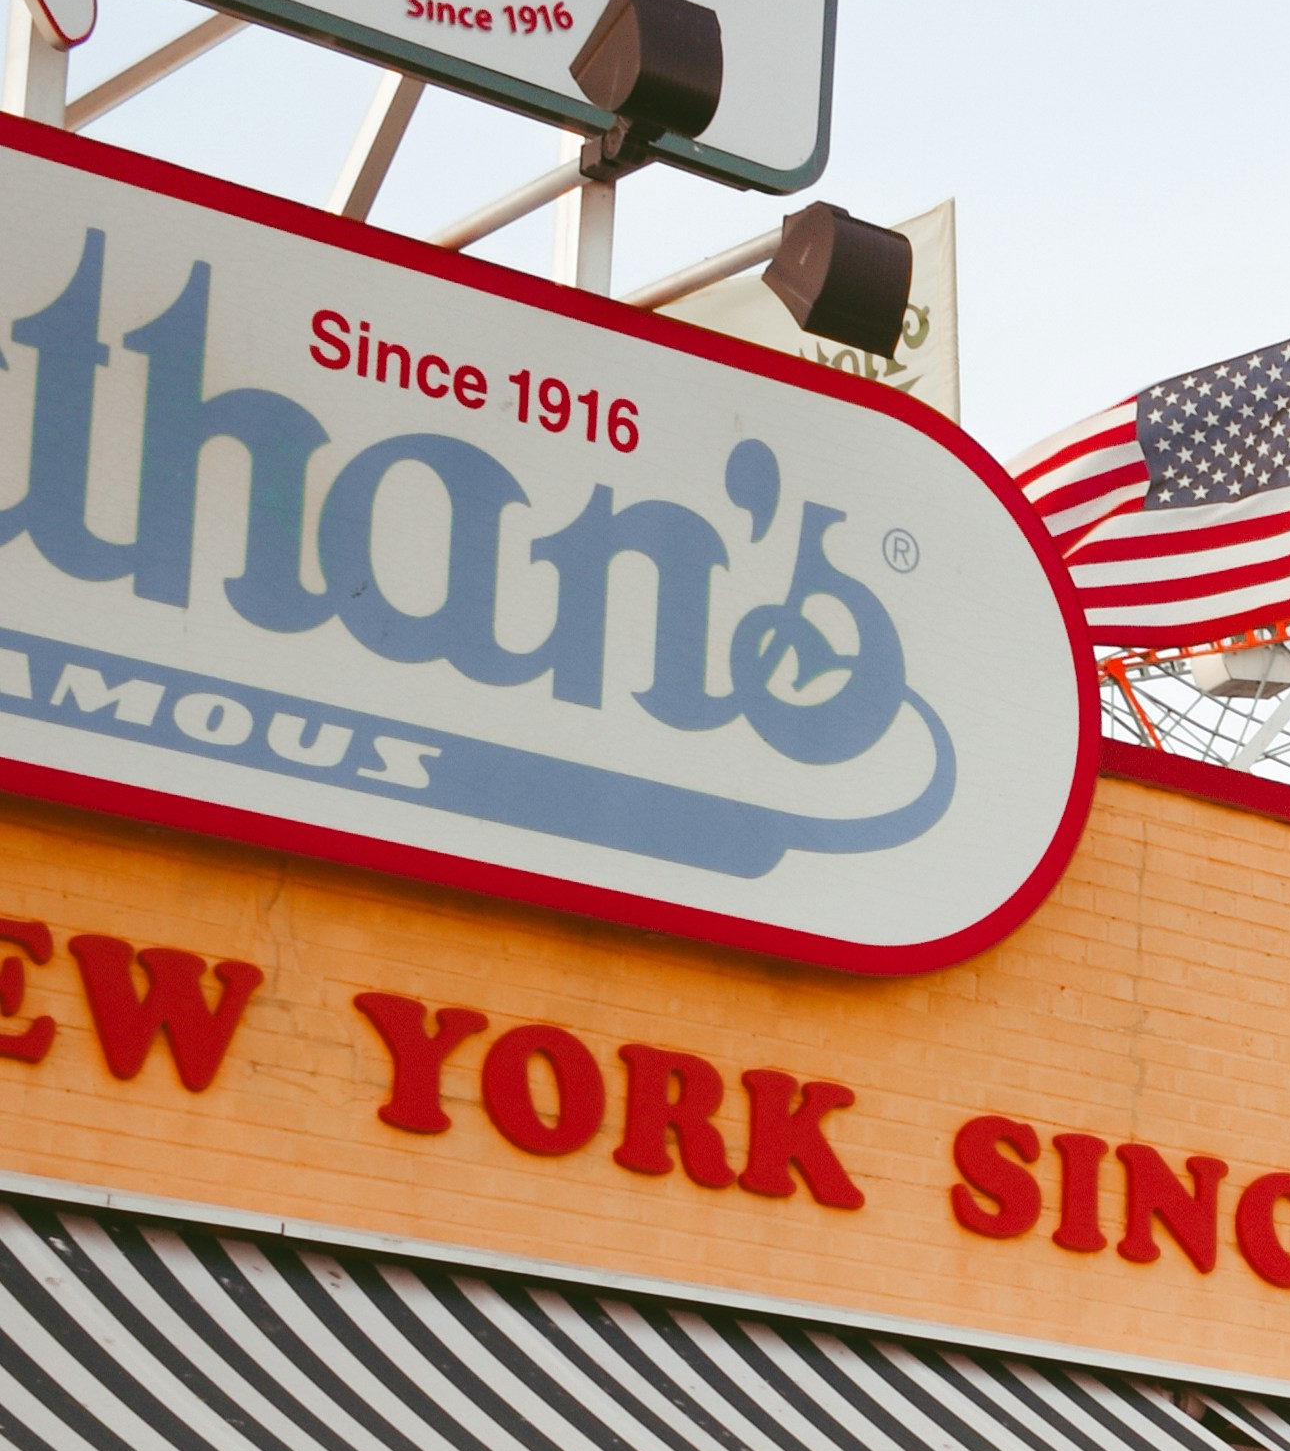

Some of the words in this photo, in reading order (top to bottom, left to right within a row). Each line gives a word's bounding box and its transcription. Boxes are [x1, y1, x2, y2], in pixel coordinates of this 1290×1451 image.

[502, 2, 575, 37] 1916
[308, 309, 488, 410] Since
[508, 369, 641, 455] 1916
[0, 227, 906, 766] than's
[353, 991, 867, 1211] YORK
